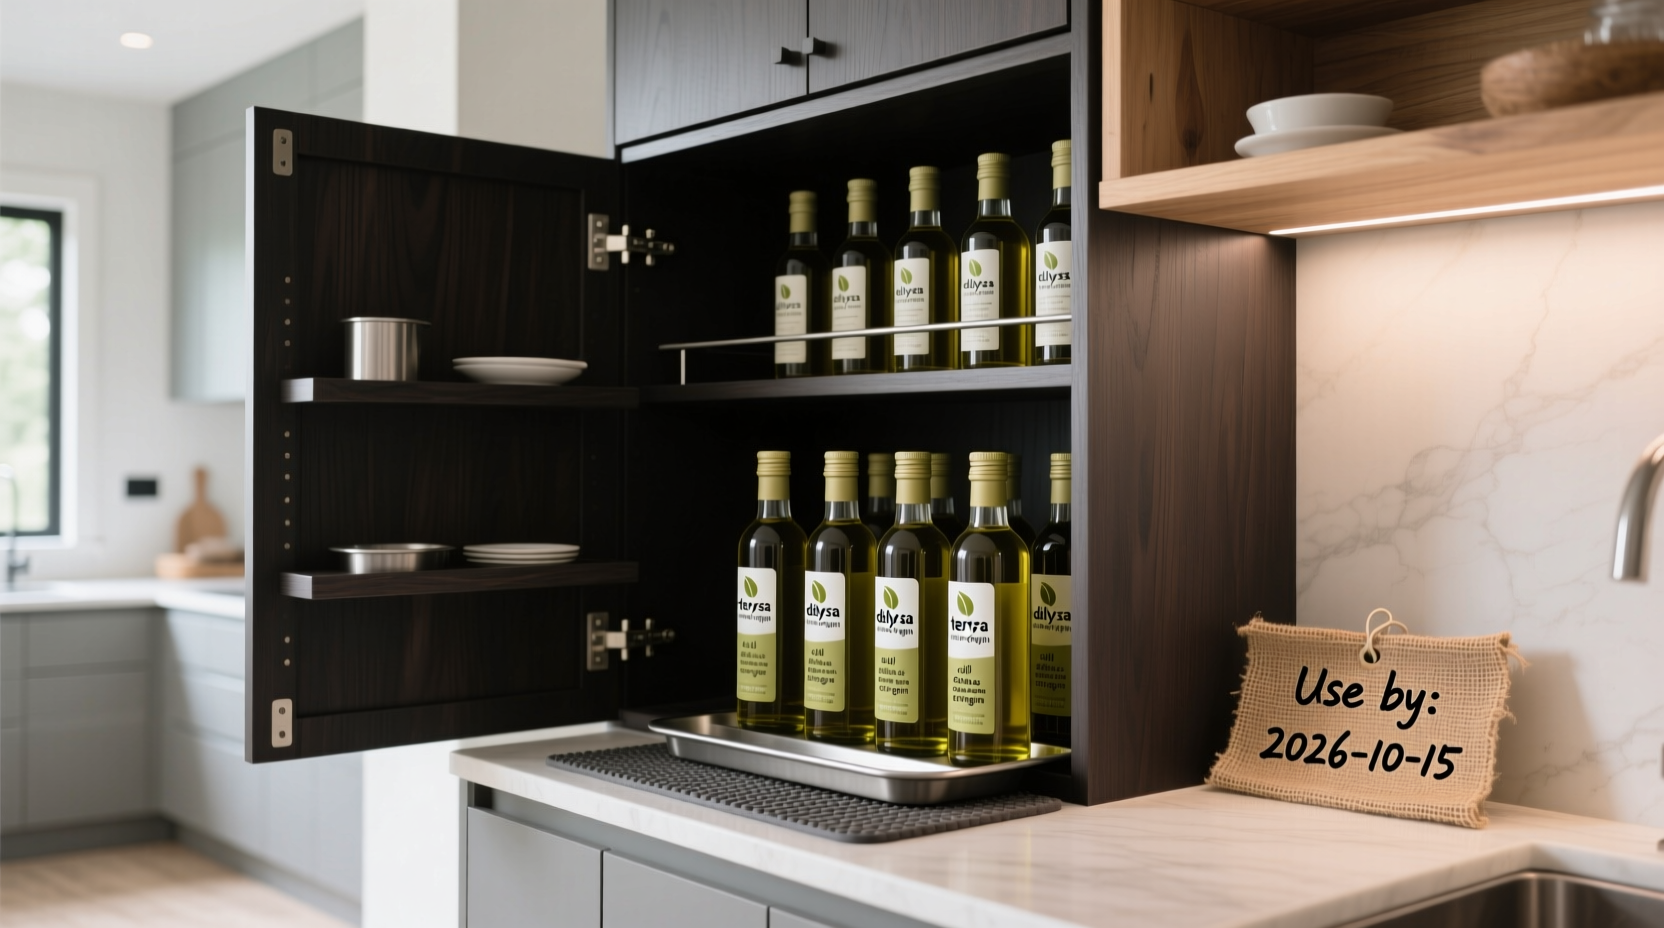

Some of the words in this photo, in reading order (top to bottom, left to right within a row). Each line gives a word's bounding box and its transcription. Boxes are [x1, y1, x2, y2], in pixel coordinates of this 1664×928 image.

[876, 608, 914, 628] dilysa
[1033, 606, 1071, 624] dilysa
[1295, 665, 1364, 709] Use
[1379, 669, 1440, 730] by:
[1259, 726, 1463, 780] 2026-10-15
